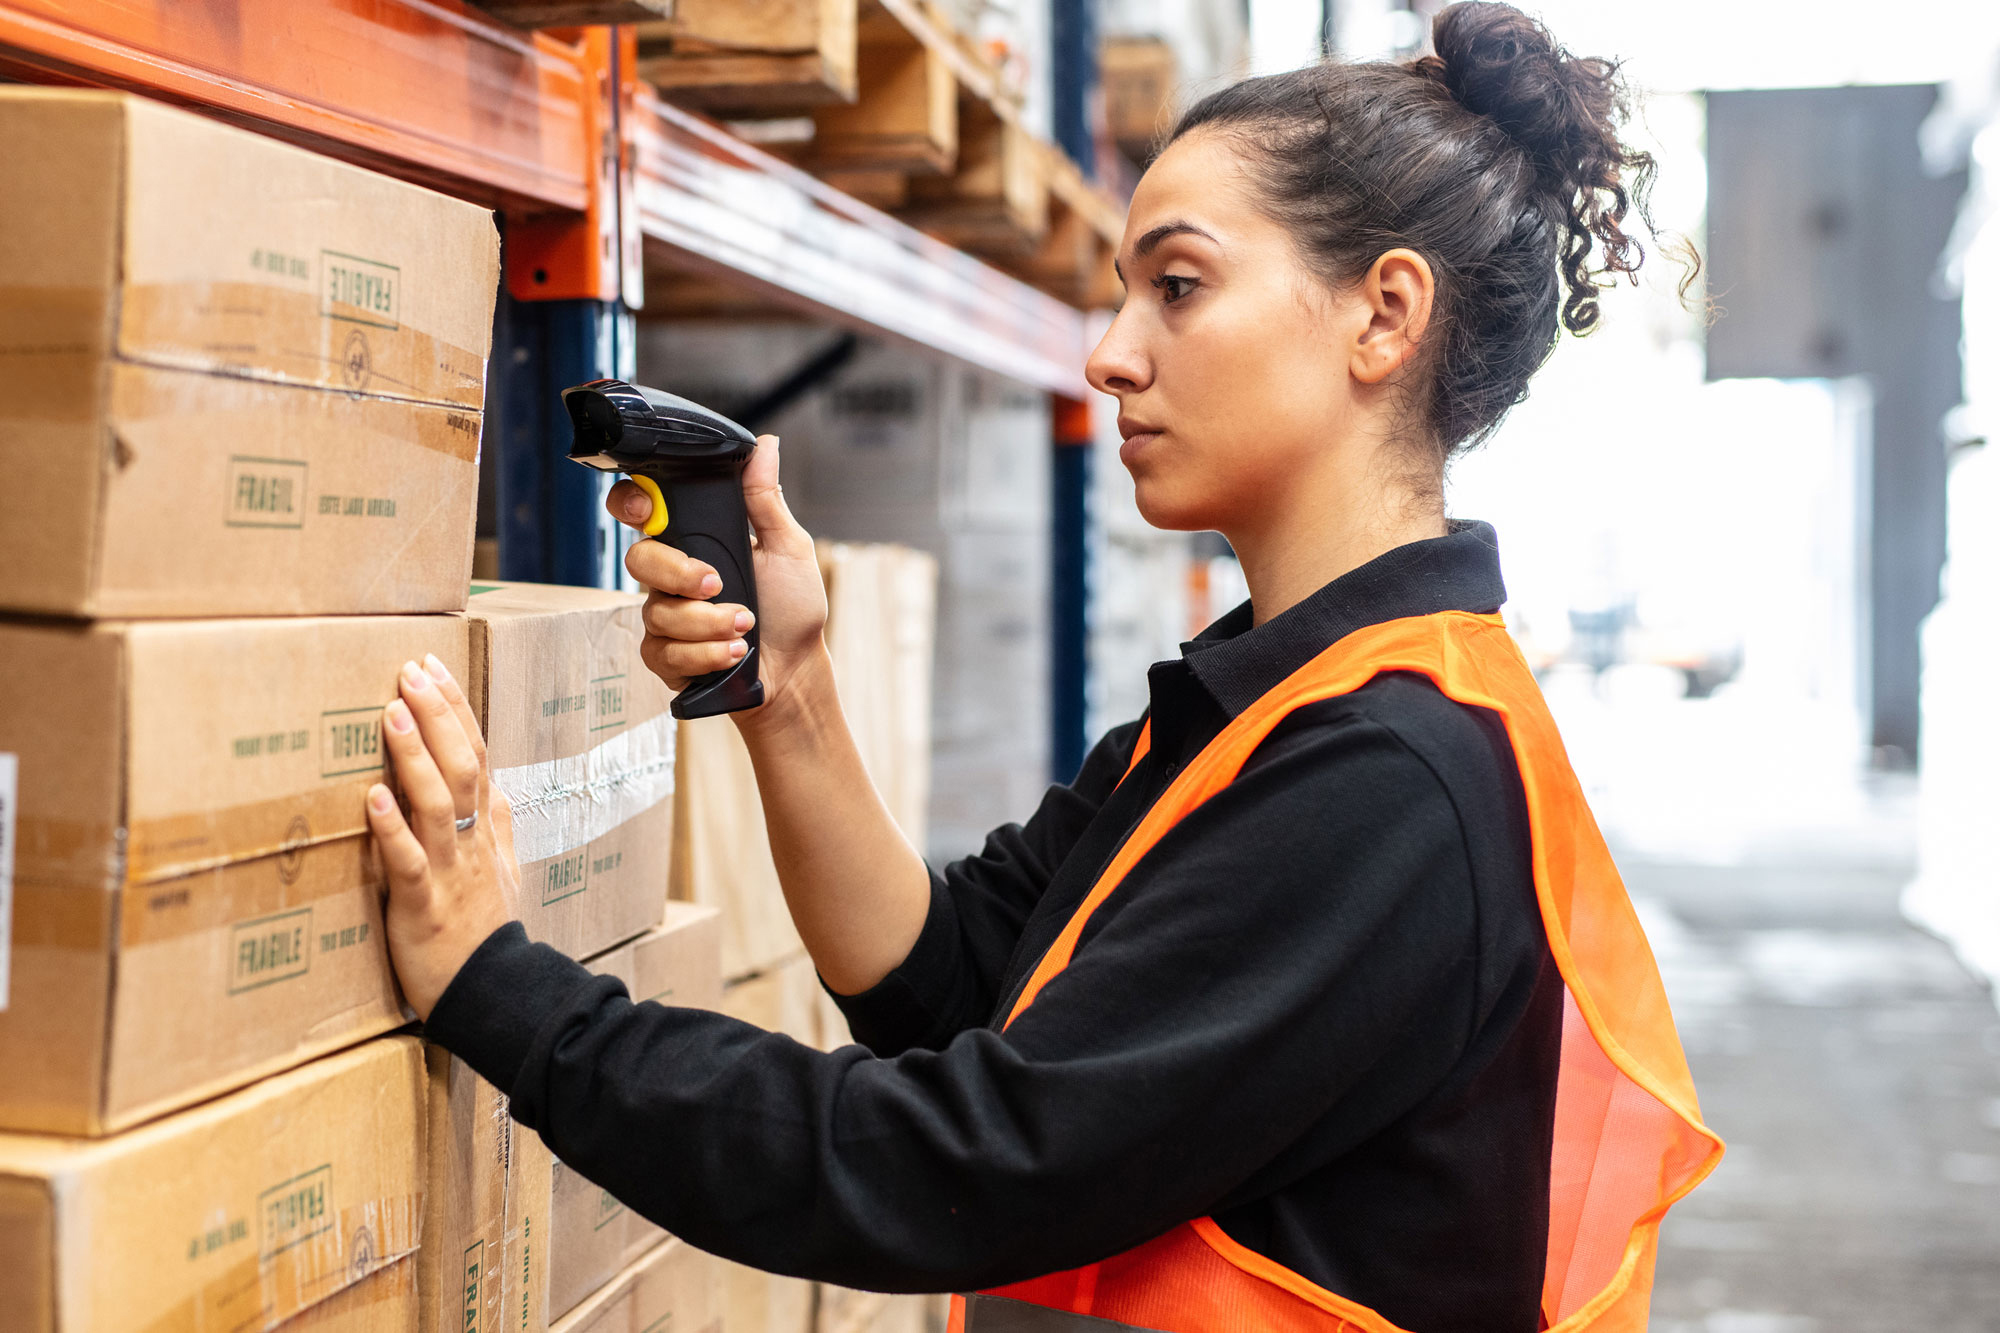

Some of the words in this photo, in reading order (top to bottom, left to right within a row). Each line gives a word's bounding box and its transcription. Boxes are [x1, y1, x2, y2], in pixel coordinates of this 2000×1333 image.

[331, 266, 392, 312] FRAGILE
[234, 474, 294, 513] FRAGIL
[595, 686, 623, 718] FRAGIL
[331, 720, 379, 758] FRAGIL
[548, 854, 584, 893] FRAGILE
[237, 926, 302, 978] FRAGILE
[267, 1181, 323, 1241] FRAGILE
[525, 1216, 529, 1238] UP
